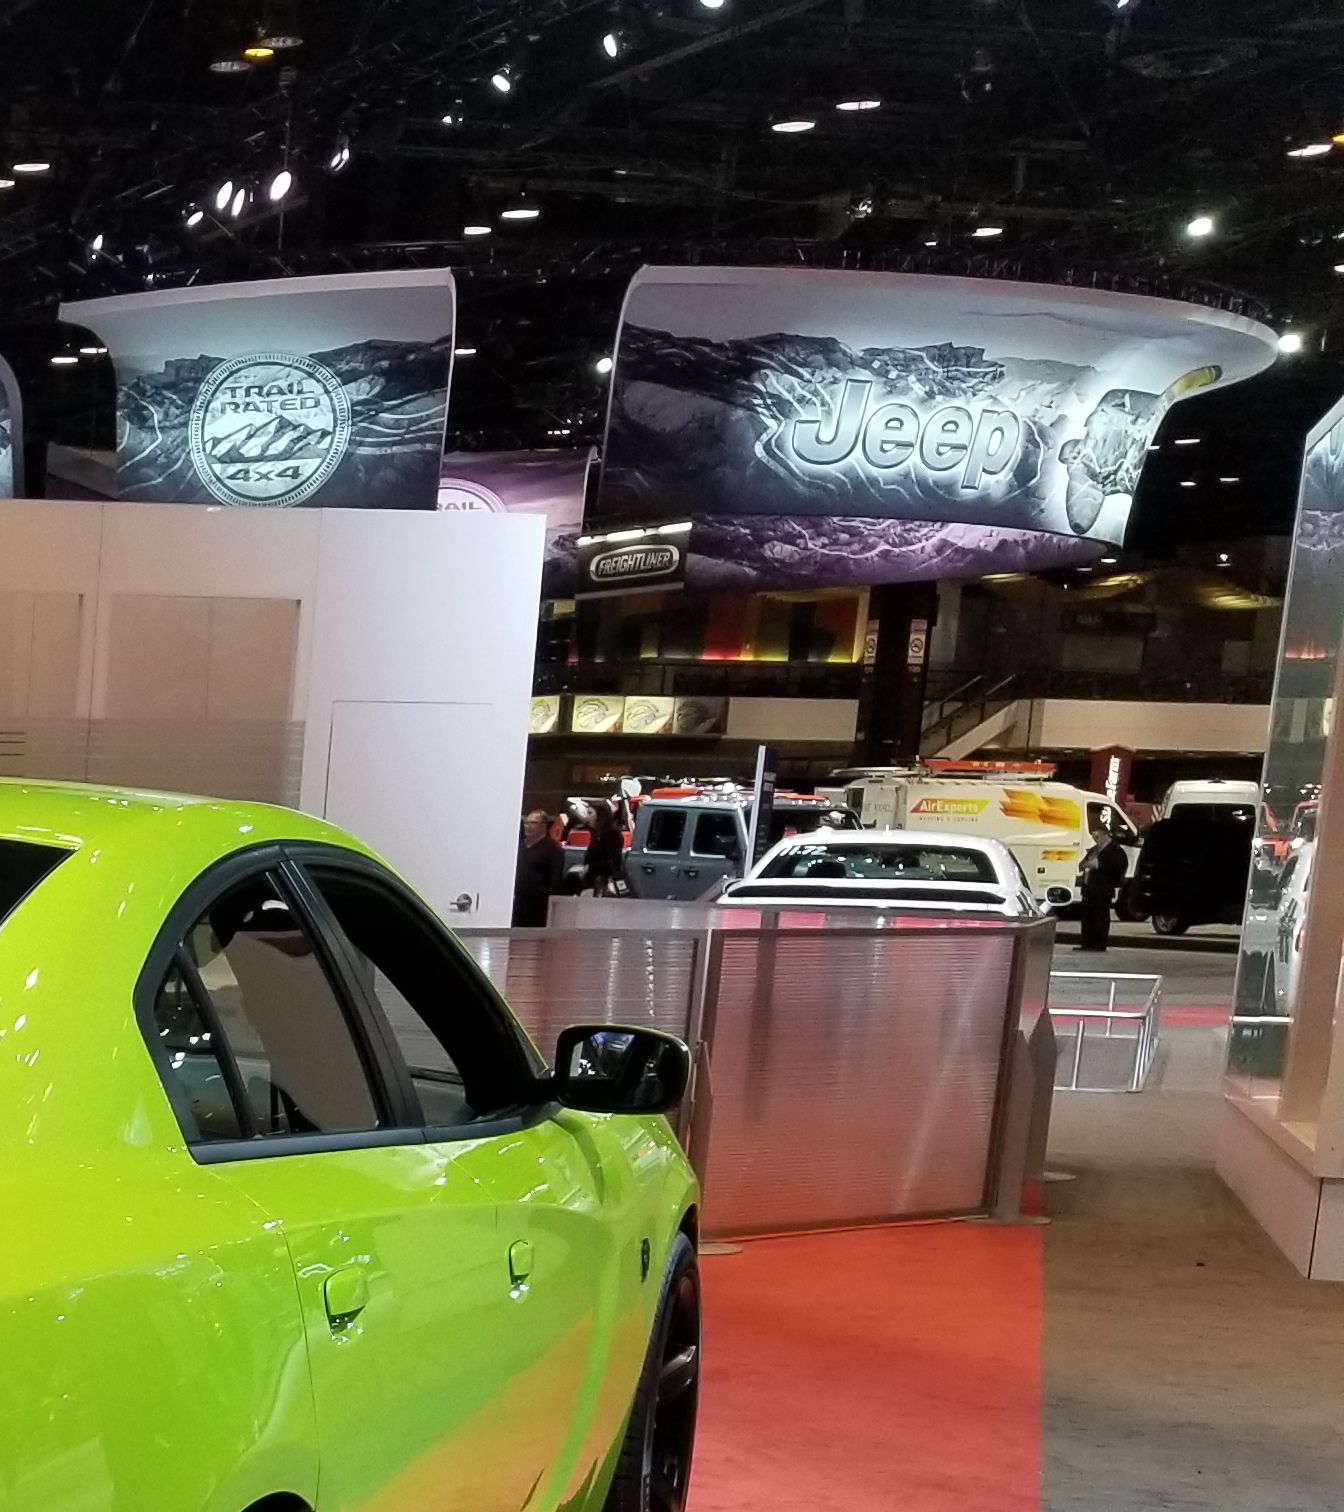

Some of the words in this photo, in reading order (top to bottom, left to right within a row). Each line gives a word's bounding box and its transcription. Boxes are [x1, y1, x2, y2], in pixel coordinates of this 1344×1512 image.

[223, 380, 315, 399] TRAIL
[220, 396, 320, 414] RATED
[792, 379, 1020, 490] Jeep
[226, 465, 302, 482] 4x4
[598, 551, 671, 575] FREIGHTLINER
[920, 799, 979, 813] AirExperts
